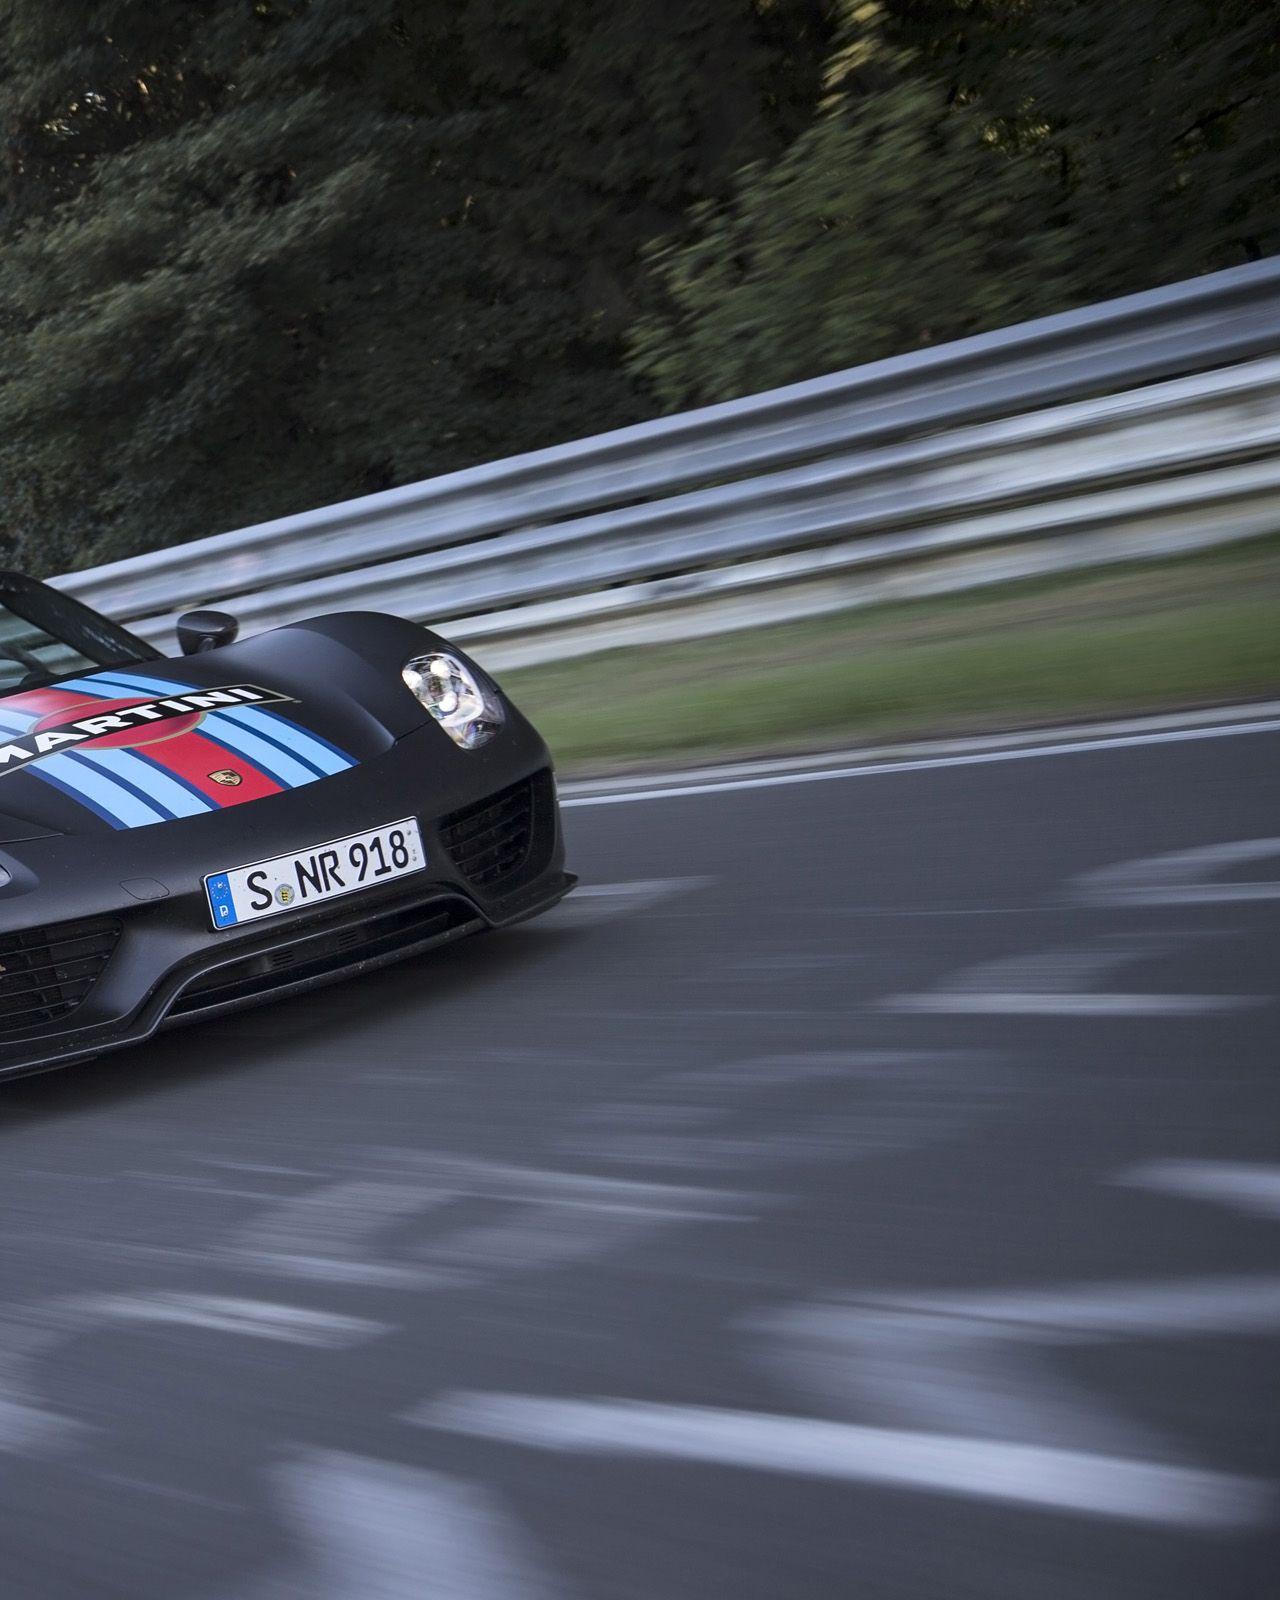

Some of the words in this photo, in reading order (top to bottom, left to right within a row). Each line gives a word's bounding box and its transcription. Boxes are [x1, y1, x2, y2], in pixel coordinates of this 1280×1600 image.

[246, 870, 273, 911] S
[294, 850, 346, 898] NR
[348, 830, 409, 882] 918
